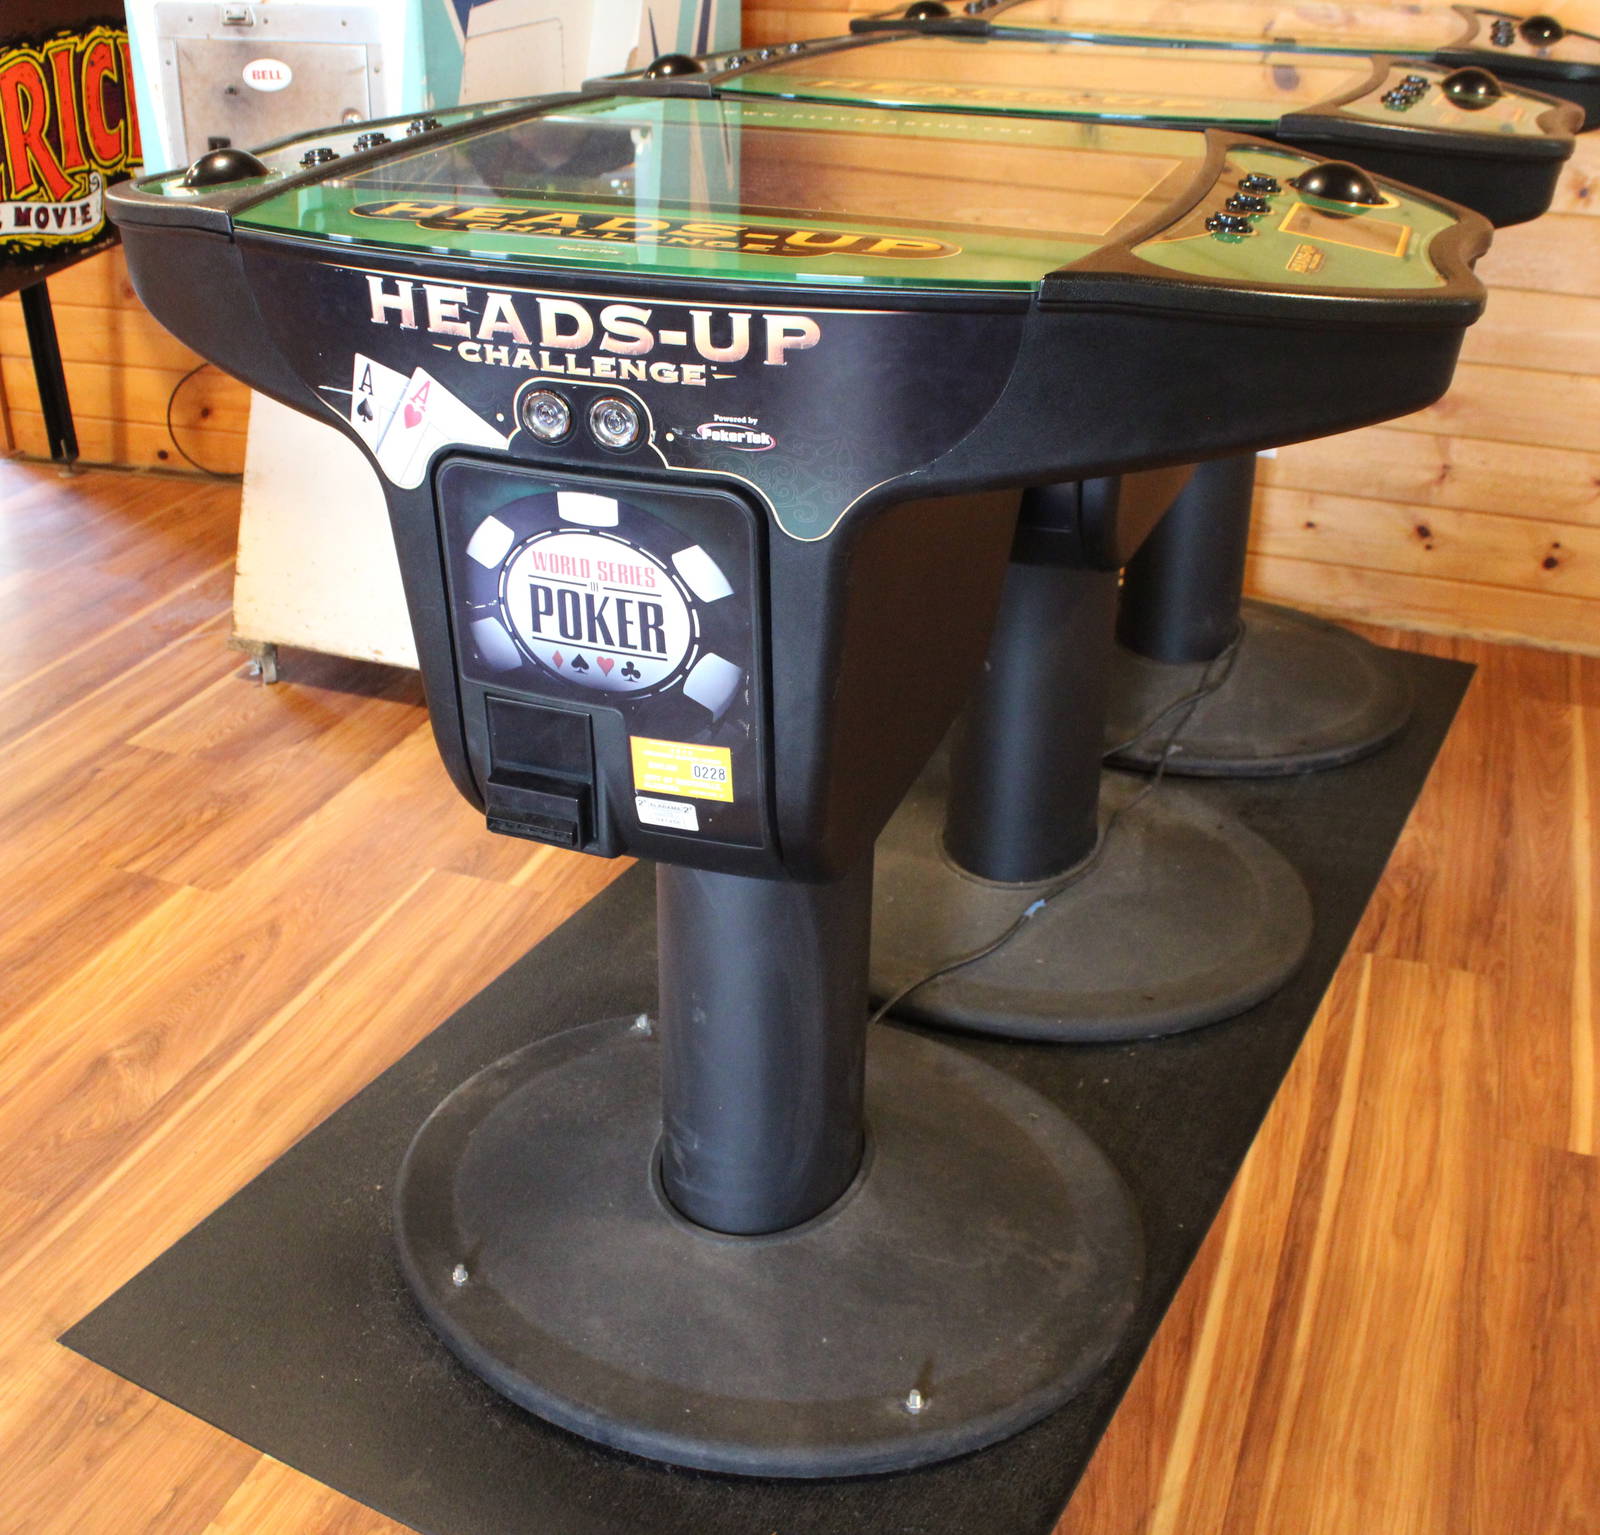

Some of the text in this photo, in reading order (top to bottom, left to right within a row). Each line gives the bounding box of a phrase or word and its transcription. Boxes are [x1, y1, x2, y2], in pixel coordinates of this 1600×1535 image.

[252, 70, 282, 80] BELL
[0, 38, 143, 201] RIC
[14, 203, 92, 229] MOVIE
[369, 202, 944, 252] HEADS-UP
[466, 223, 776, 252] CHALLENGE
[365, 275, 821, 366] HEADS-UP
[359, 363, 373, 396] A
[457, 341, 707, 386] CHALLENGE
[410, 380, 431, 412] A
[713, 414, 758, 425] Powered by
[701, 428, 771, 445] PokerTek
[531, 550, 656, 588] WORLD SERIES
[529, 583, 667, 655] POKER
[693, 765, 726, 781] 0228
